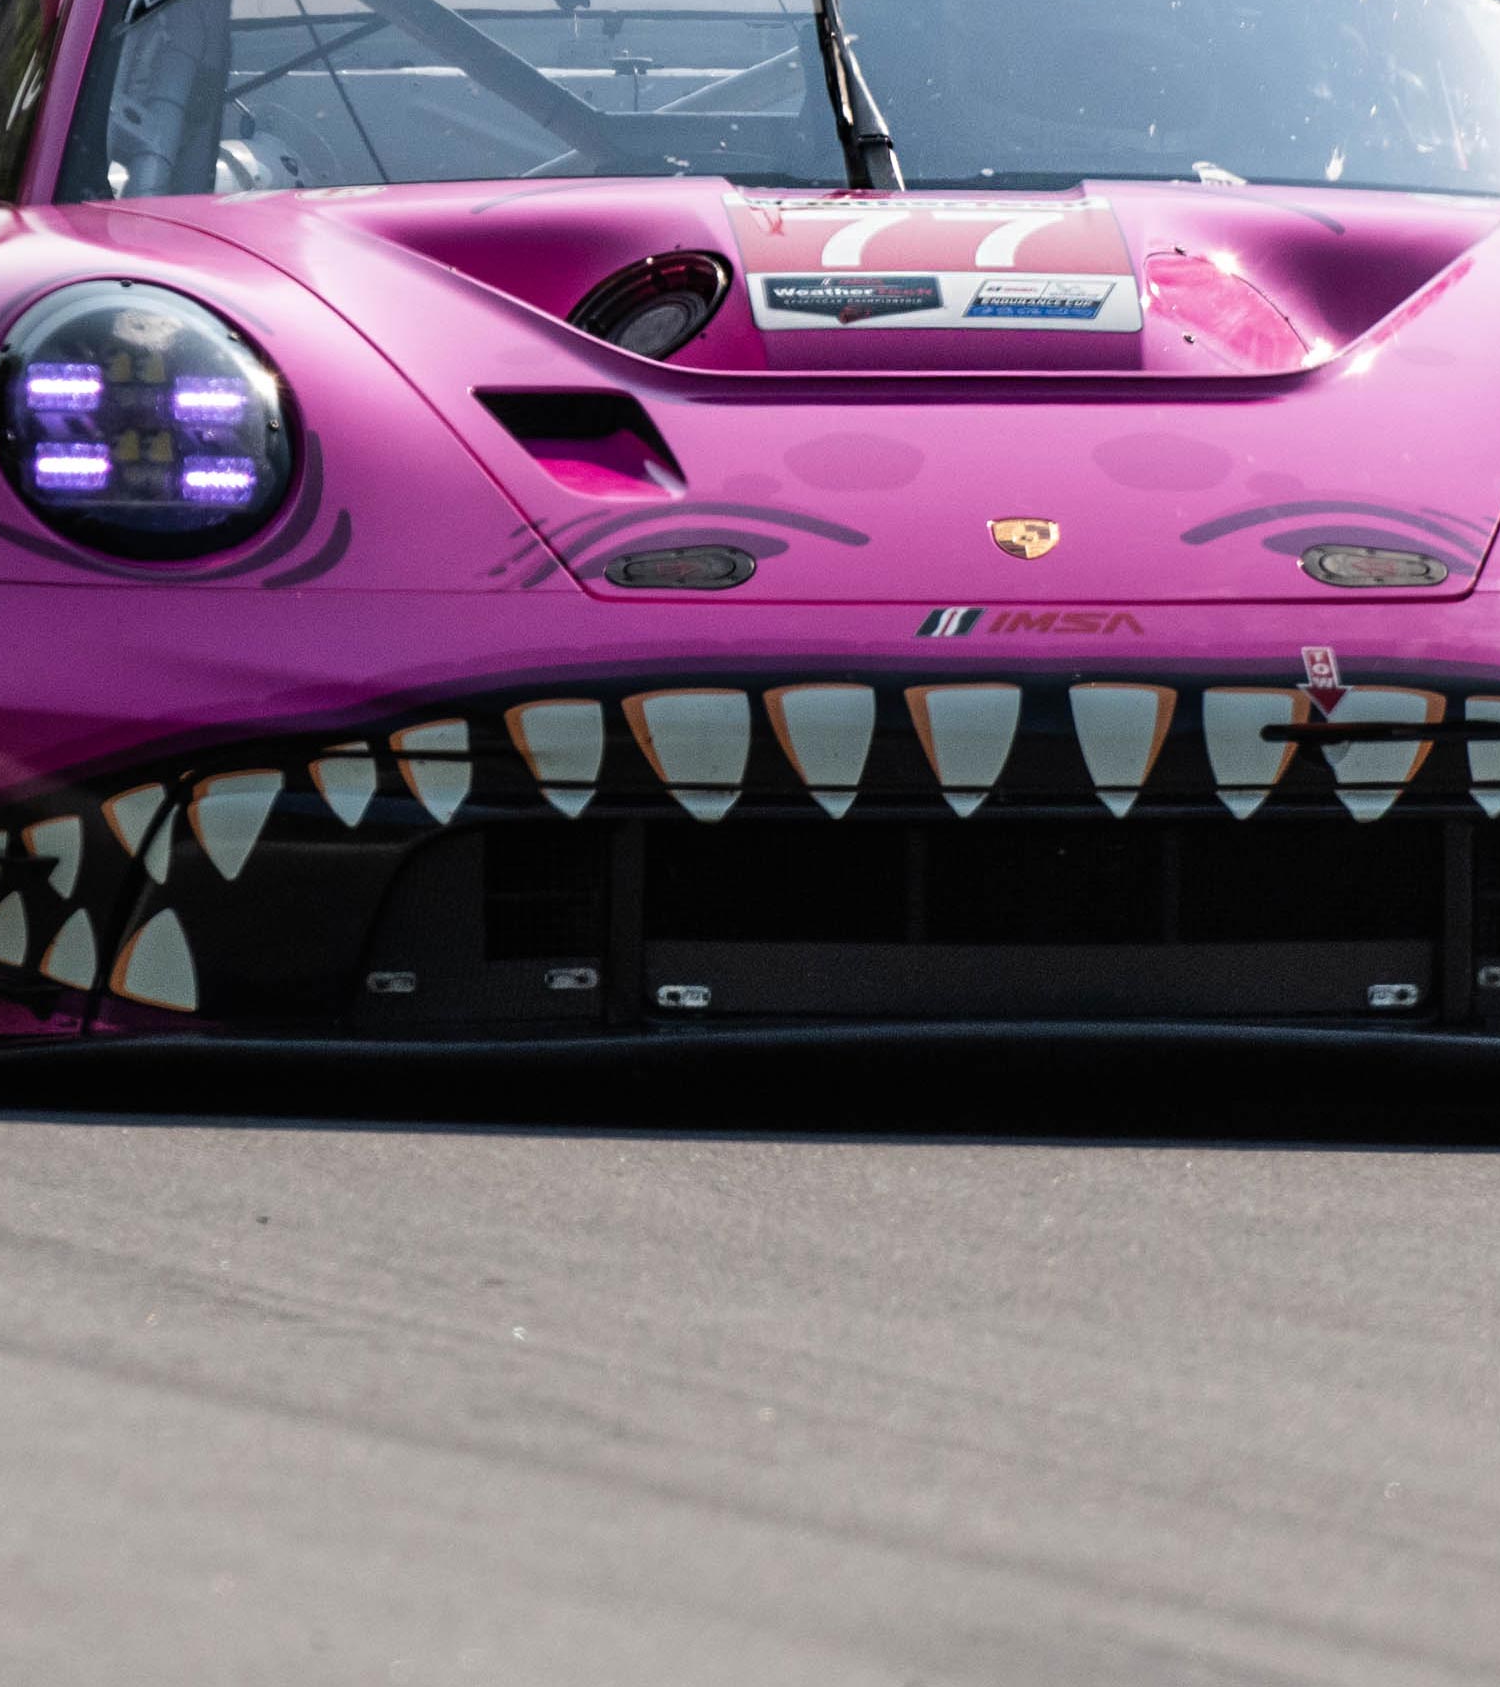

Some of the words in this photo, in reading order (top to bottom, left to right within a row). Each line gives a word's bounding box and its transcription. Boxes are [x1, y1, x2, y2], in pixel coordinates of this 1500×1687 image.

[778, 210, 1064, 267] 77
[980, 297, 1058, 307] ENDURANCE
[1065, 299, 1093, 308] CUP
[987, 612, 1145, 635] IMSA
[1305, 650, 1335, 688] TOW
